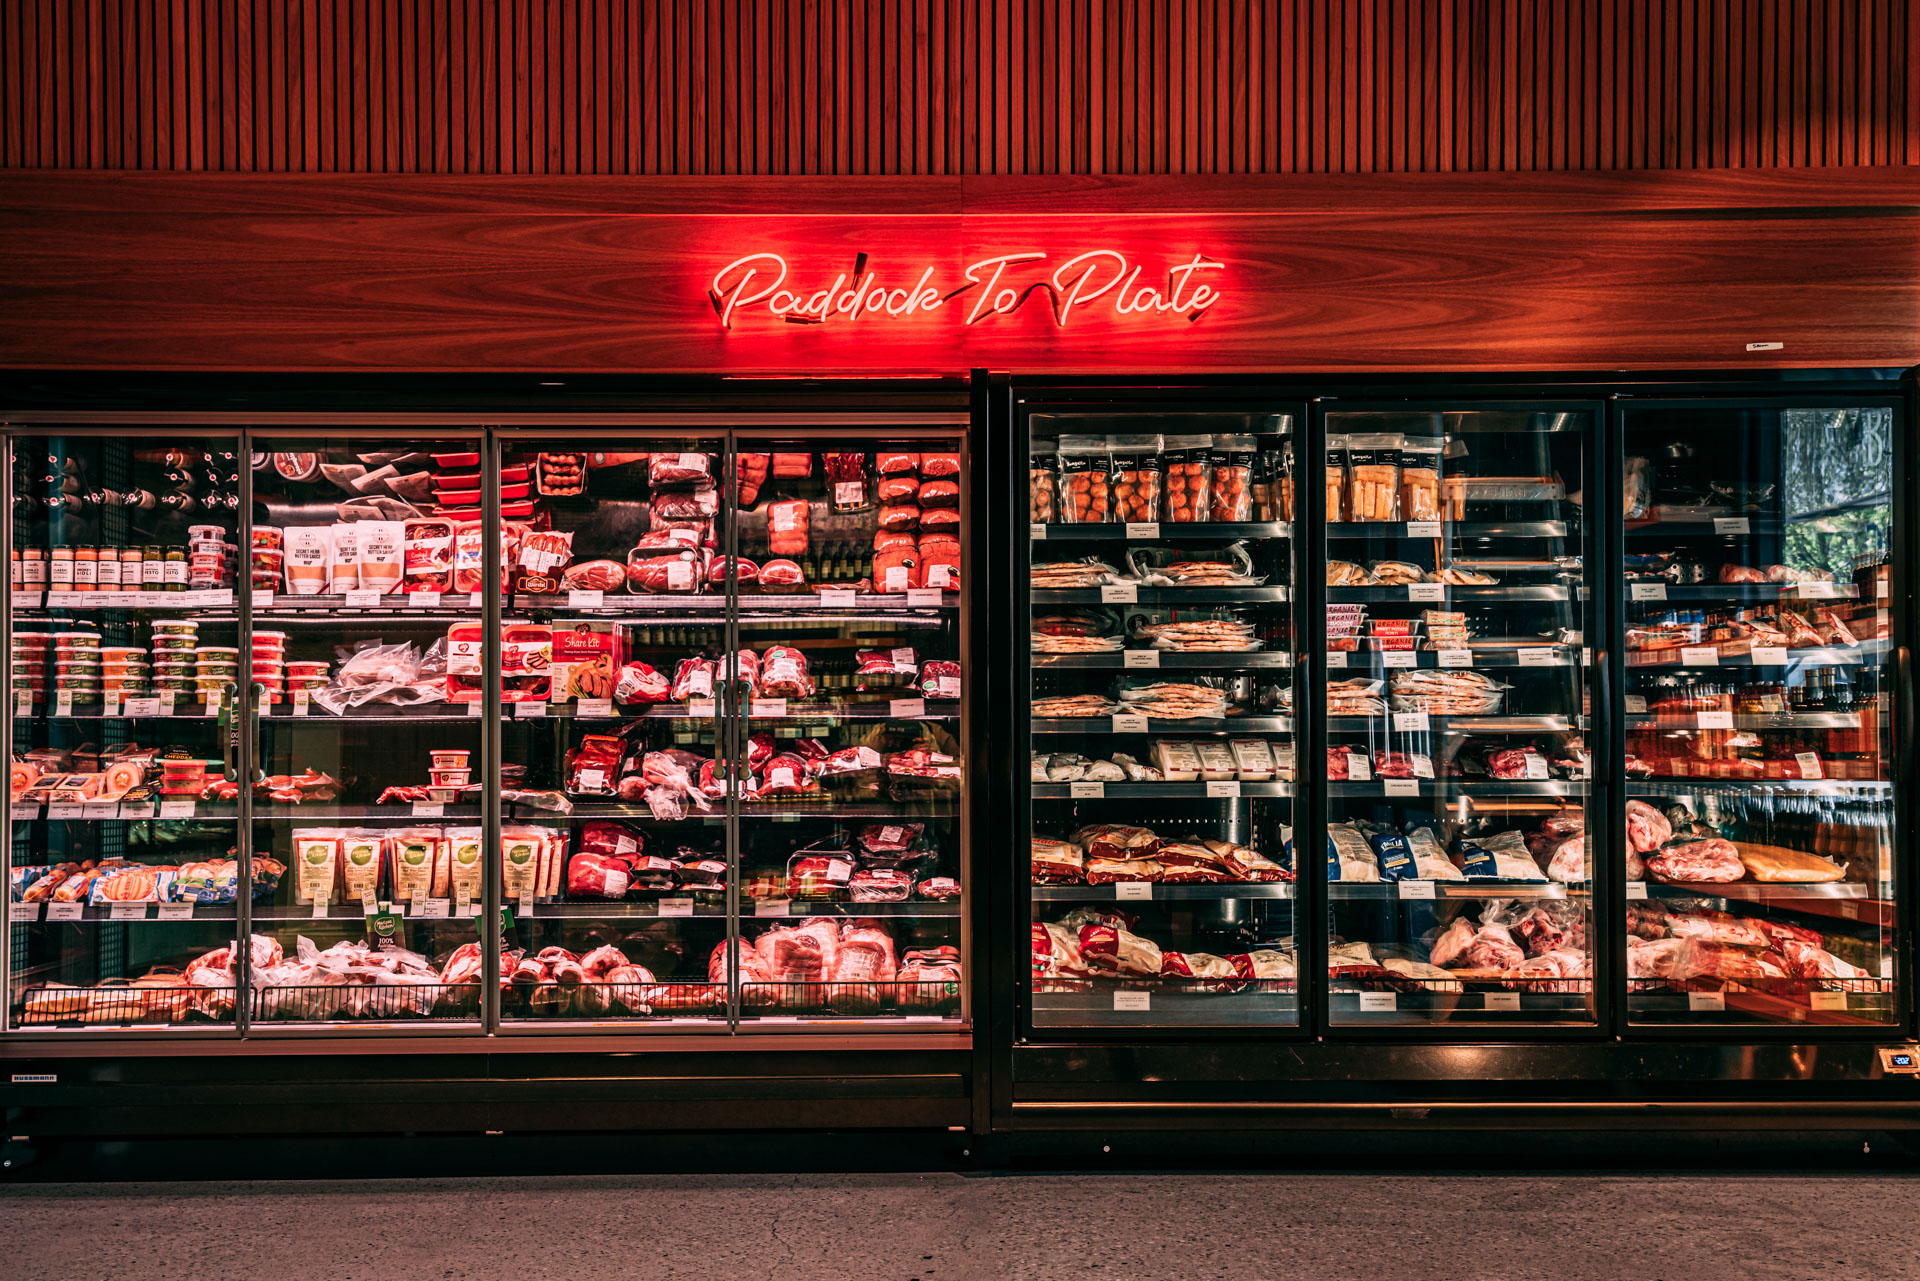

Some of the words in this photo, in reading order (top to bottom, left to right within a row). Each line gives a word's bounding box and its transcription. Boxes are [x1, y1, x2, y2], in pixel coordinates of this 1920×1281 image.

[712, 252, 944, 328] Paddock
[965, 251, 1047, 326] To
[1052, 249, 1225, 327] Plate
[564, 636, 587, 648] Share
[588, 636, 600, 648] Kit
